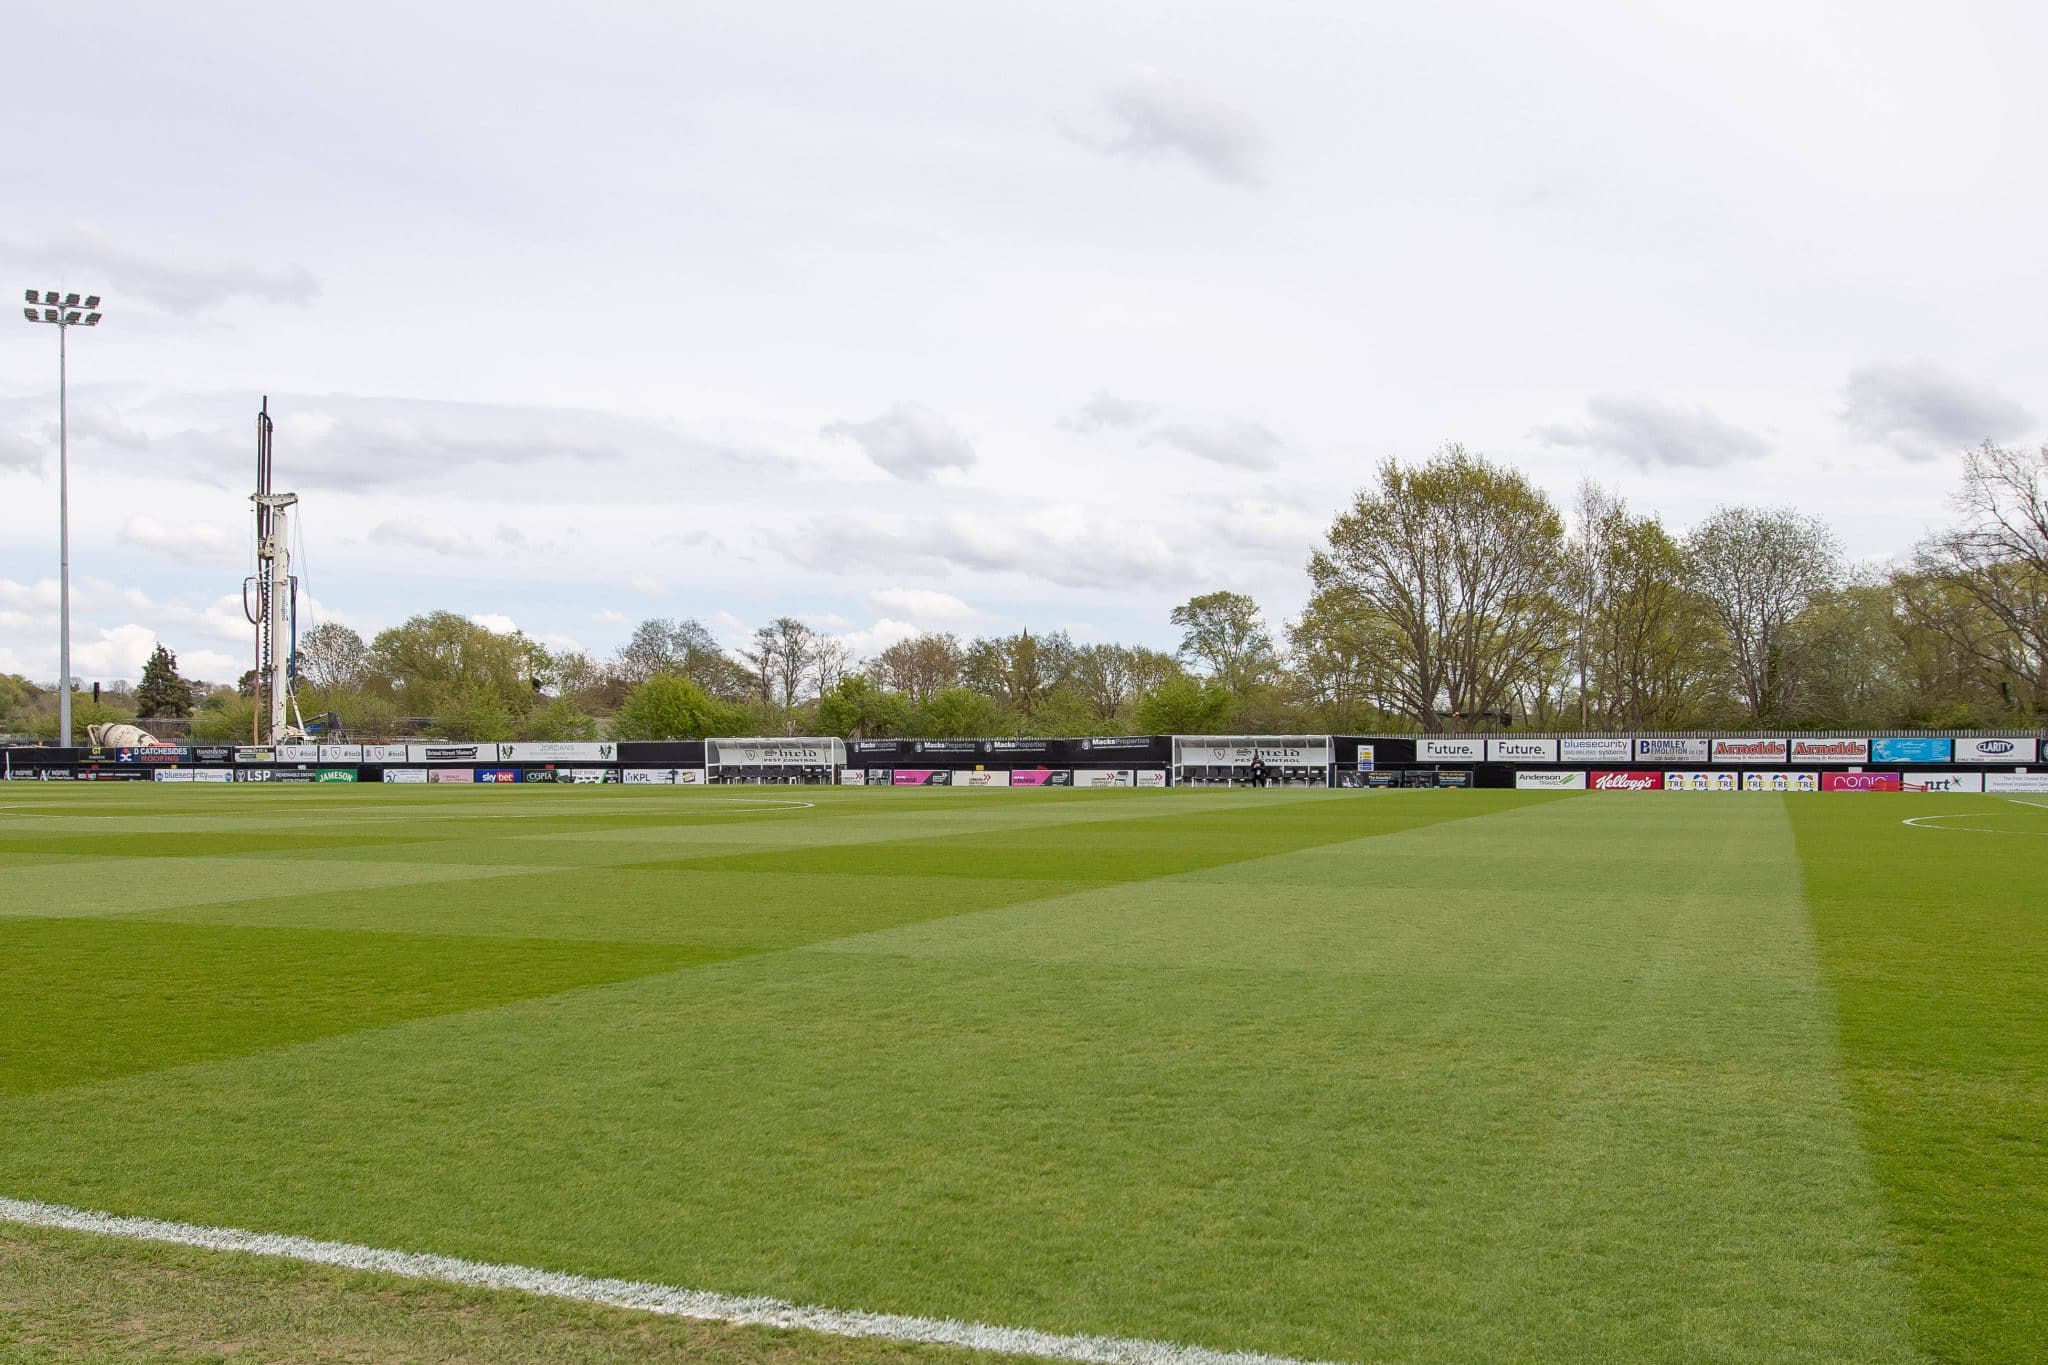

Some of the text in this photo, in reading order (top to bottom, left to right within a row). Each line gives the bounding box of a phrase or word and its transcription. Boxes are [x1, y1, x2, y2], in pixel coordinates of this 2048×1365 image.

[540, 744, 575, 752] JORDANS
[1427, 742, 1473, 754] Future.
[1498, 742, 1546, 754] Future.
[1564, 740, 1627, 749] bluesecurity
[1714, 742, 1785, 754] Arnolds
[1793, 742, 1866, 755] Arnolds
[1978, 742, 2012, 752] CLARITY
[764, 749, 817, 757] Shield
[164, 770, 208, 780] bluesecurity
[247, 770, 271, 782] LSP
[319, 771, 353, 782] JAMESON
[482, 772, 512, 782] sky bet
[1596, 772, 1653, 790] Kellogg's
[1924, 779, 1950, 790] nrt
